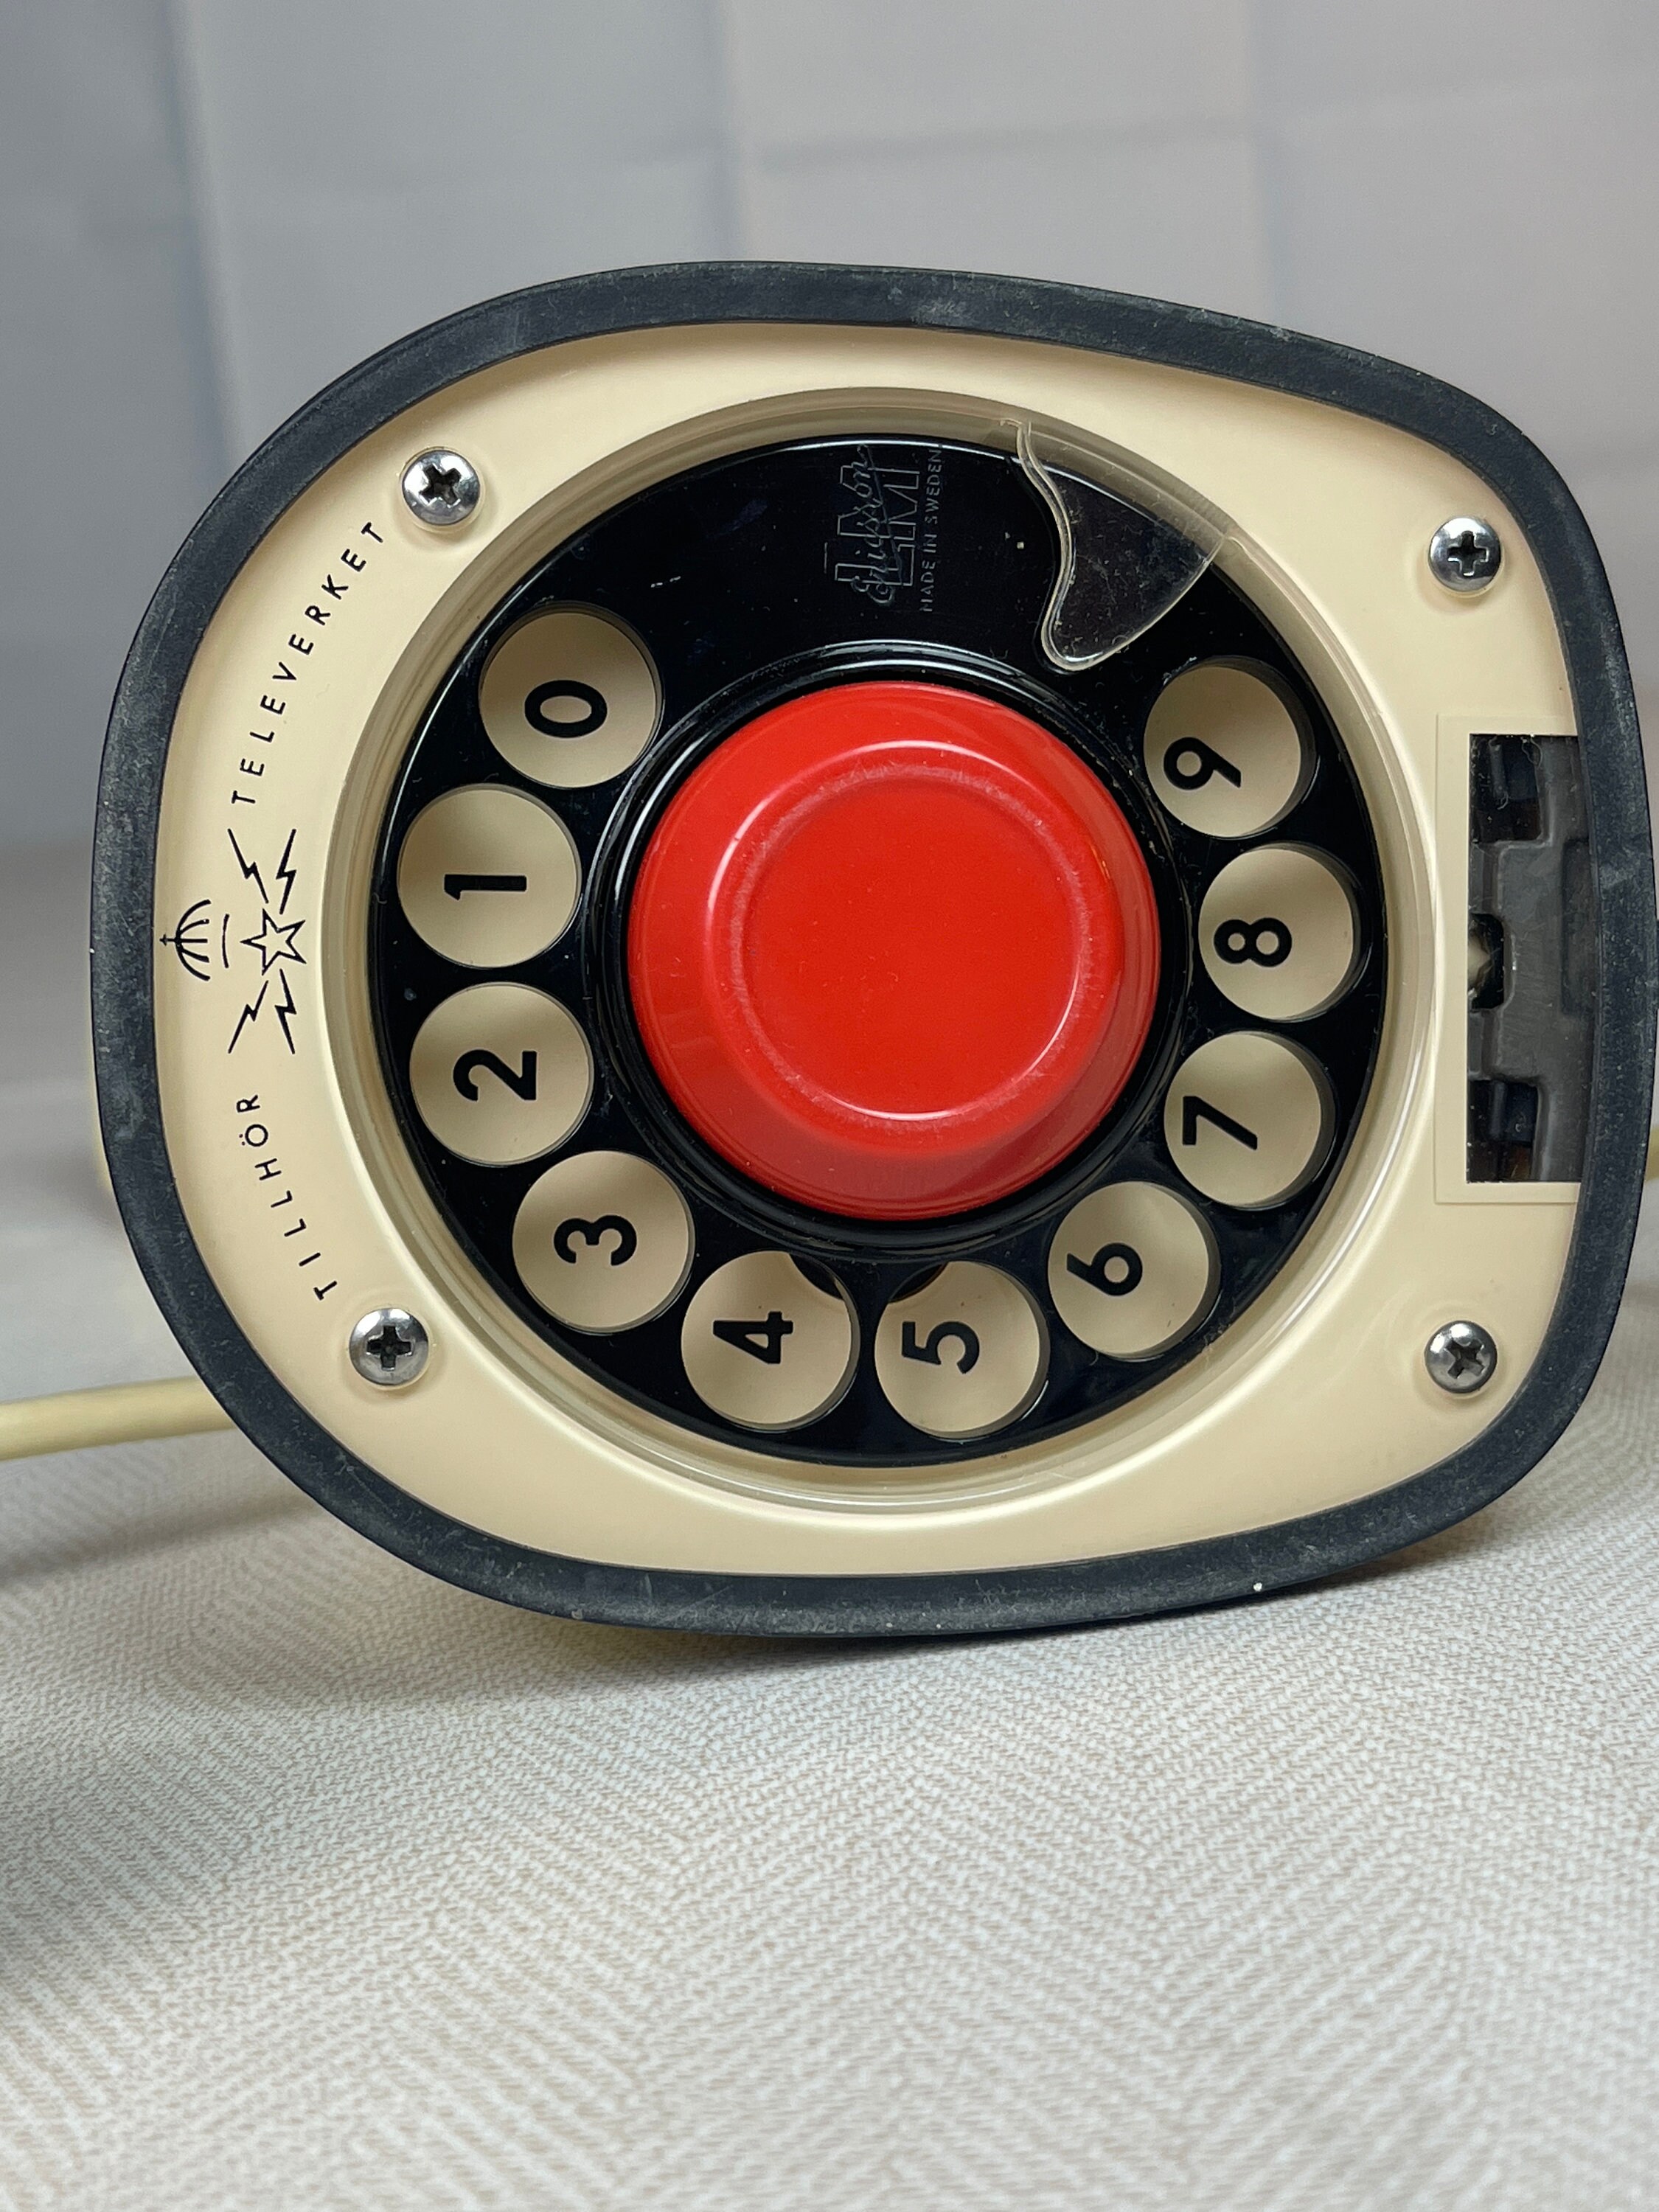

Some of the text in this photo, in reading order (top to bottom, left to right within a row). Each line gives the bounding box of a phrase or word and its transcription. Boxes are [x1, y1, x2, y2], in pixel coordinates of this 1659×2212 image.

[850, 444, 897, 605] Ericsson
[919, 448, 942, 612] MADE IN SWEDEN
[524, 679, 608, 738] 0
[1163, 736, 1242, 790] 9
[231, 521, 383, 1301] TILLHÖR TELEVERKET
[443, 874, 527, 901] 1
[1213, 917, 1293, 967] 8
[452, 1049, 538, 1101] 2
[1182, 1095, 1258, 1150] 7
[553, 1214, 637, 1265] 3
[1066, 1242, 1143, 1295] 6
[712, 1310, 794, 1364] 4
[901, 1321, 980, 1374] 5
